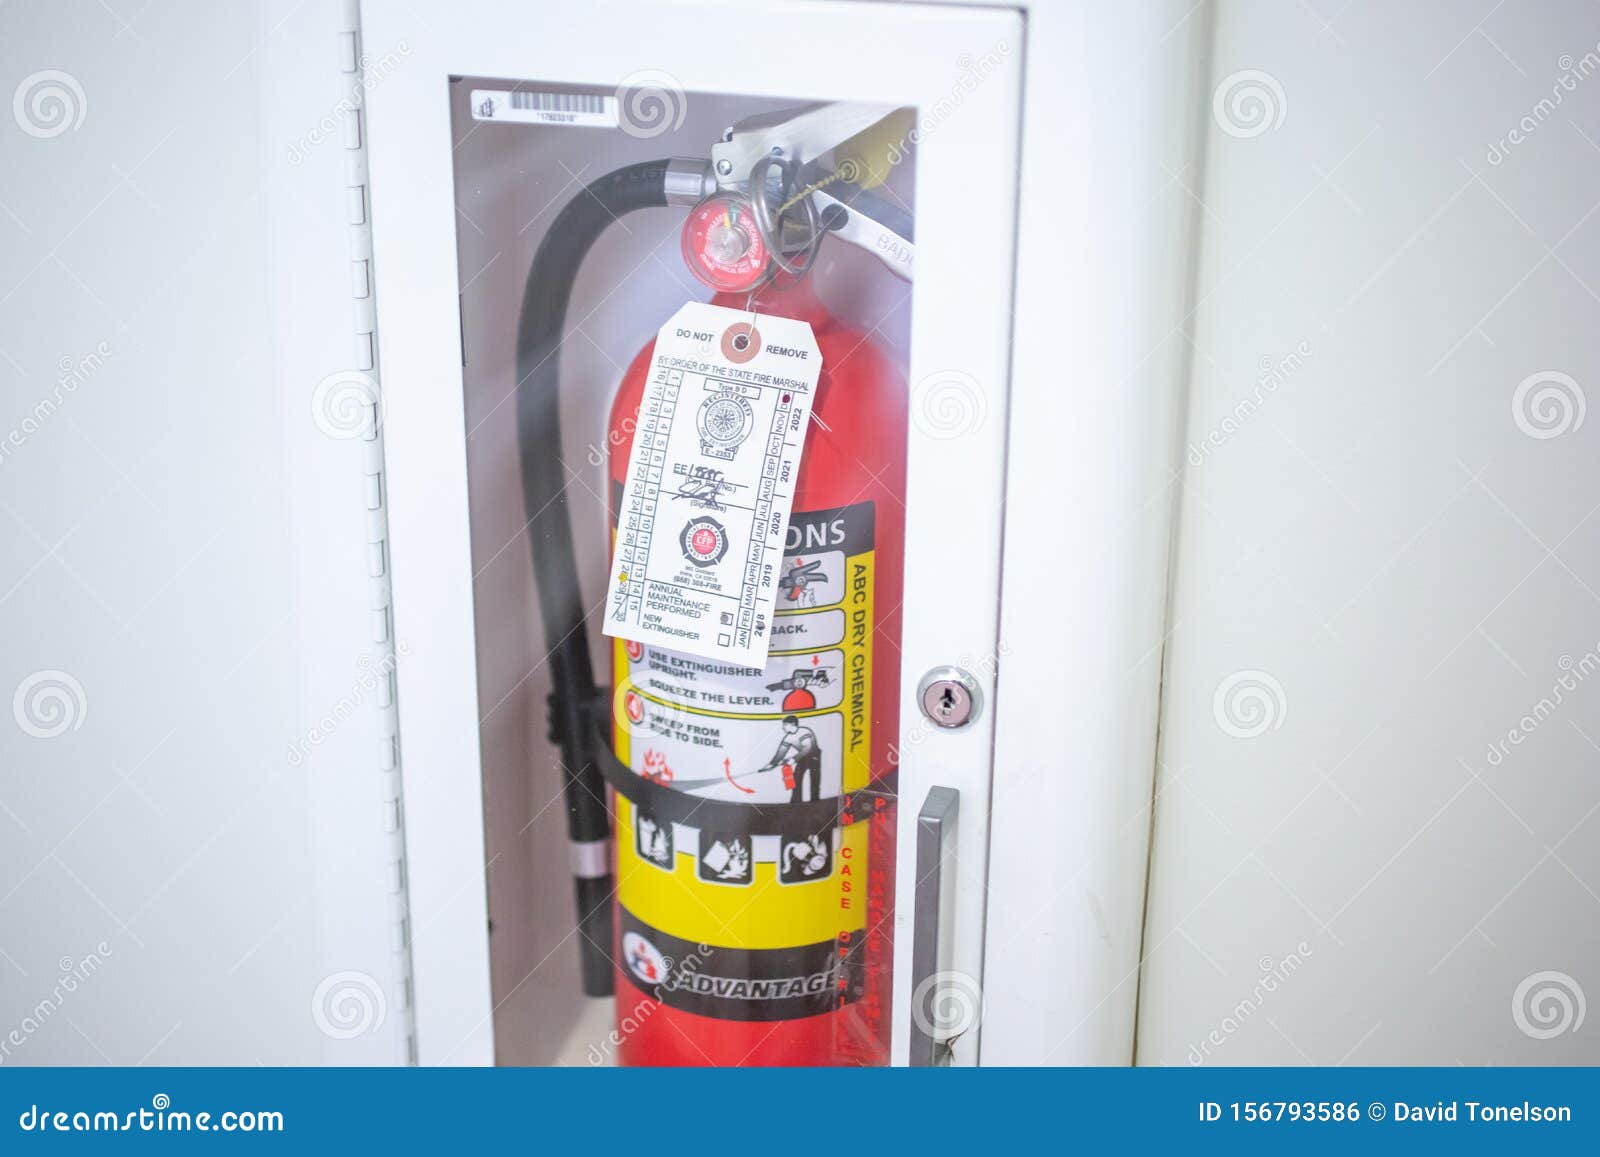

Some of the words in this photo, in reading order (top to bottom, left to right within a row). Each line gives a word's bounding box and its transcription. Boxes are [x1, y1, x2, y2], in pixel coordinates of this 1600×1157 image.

[879, 233, 914, 264] BAD
[676, 329, 692, 338] DO
[694, 332, 714, 342] NOT
[766, 346, 808, 359] REMOVE
[658, 370, 666, 380] 16
[671, 357, 698, 370] ORDER
[712, 366, 727, 376] THE
[729, 369, 752, 381] STATE
[754, 374, 770, 384] FIRE
[772, 377, 808, 390] MARSHAL
[655, 387, 663, 397] 17
[650, 402, 658, 412] 18
[646, 418, 656, 429] 19
[776, 413, 785, 432] NOV
[643, 434, 652, 446] 20
[771, 436, 780, 454] OCT
[640, 450, 649, 462] 21
[637, 467, 646, 479] 22
[767, 458, 776, 476] SEP
[634, 484, 643, 495] 23
[763, 480, 772, 500] AUG
[632, 500, 640, 512] 24
[760, 504, 768, 518] JUL
[629, 516, 637, 528] 25
[642, 519, 650, 530] 10
[754, 614, 766, 637] 28
[762, 564, 772, 588] 2019
[770, 512, 782, 536] 2020
[781, 460, 792, 483] 2021
[790, 408, 802, 432] 2022
[626, 532, 634, 544] 26
[755, 522, 764, 540] JUN
[640, 536, 648, 545] 11
[624, 549, 632, 560] 27
[638, 552, 646, 562] 12
[752, 544, 761, 562] MAY
[635, 568, 643, 578] 13
[748, 564, 758, 582] APR
[632, 584, 641, 594] 14
[650, 584, 684, 597] ANNUAL
[853, 564, 867, 605] ABC
[648, 592, 710, 612] MAINTENANCE
[745, 587, 754, 606] MAR
[630, 601, 638, 610] 15
[646, 602, 702, 618] PERFORMED
[644, 614, 662, 623] NEW
[742, 610, 750, 627] FEB
[642, 624, 700, 640] EXTINGUISHER
[852, 610, 866, 648] DRY
[739, 630, 748, 648] JAN
[648, 650, 667, 663] USE
[671, 657, 762, 677] EXTINGUISHER
[648, 660, 697, 680] UPRIGHT.
[650, 678, 697, 699] SQUEEZE
[700, 692, 725, 704] THE
[729, 696, 774, 706] LEVER.
[848, 655, 866, 753] CHEMICAL
[688, 724, 720, 737] FROM
[676, 732, 689, 742] TO
[693, 736, 724, 748] SIDE.
[840, 847, 853, 910] CASE
[679, 970, 836, 1000] ADVANTAGE
